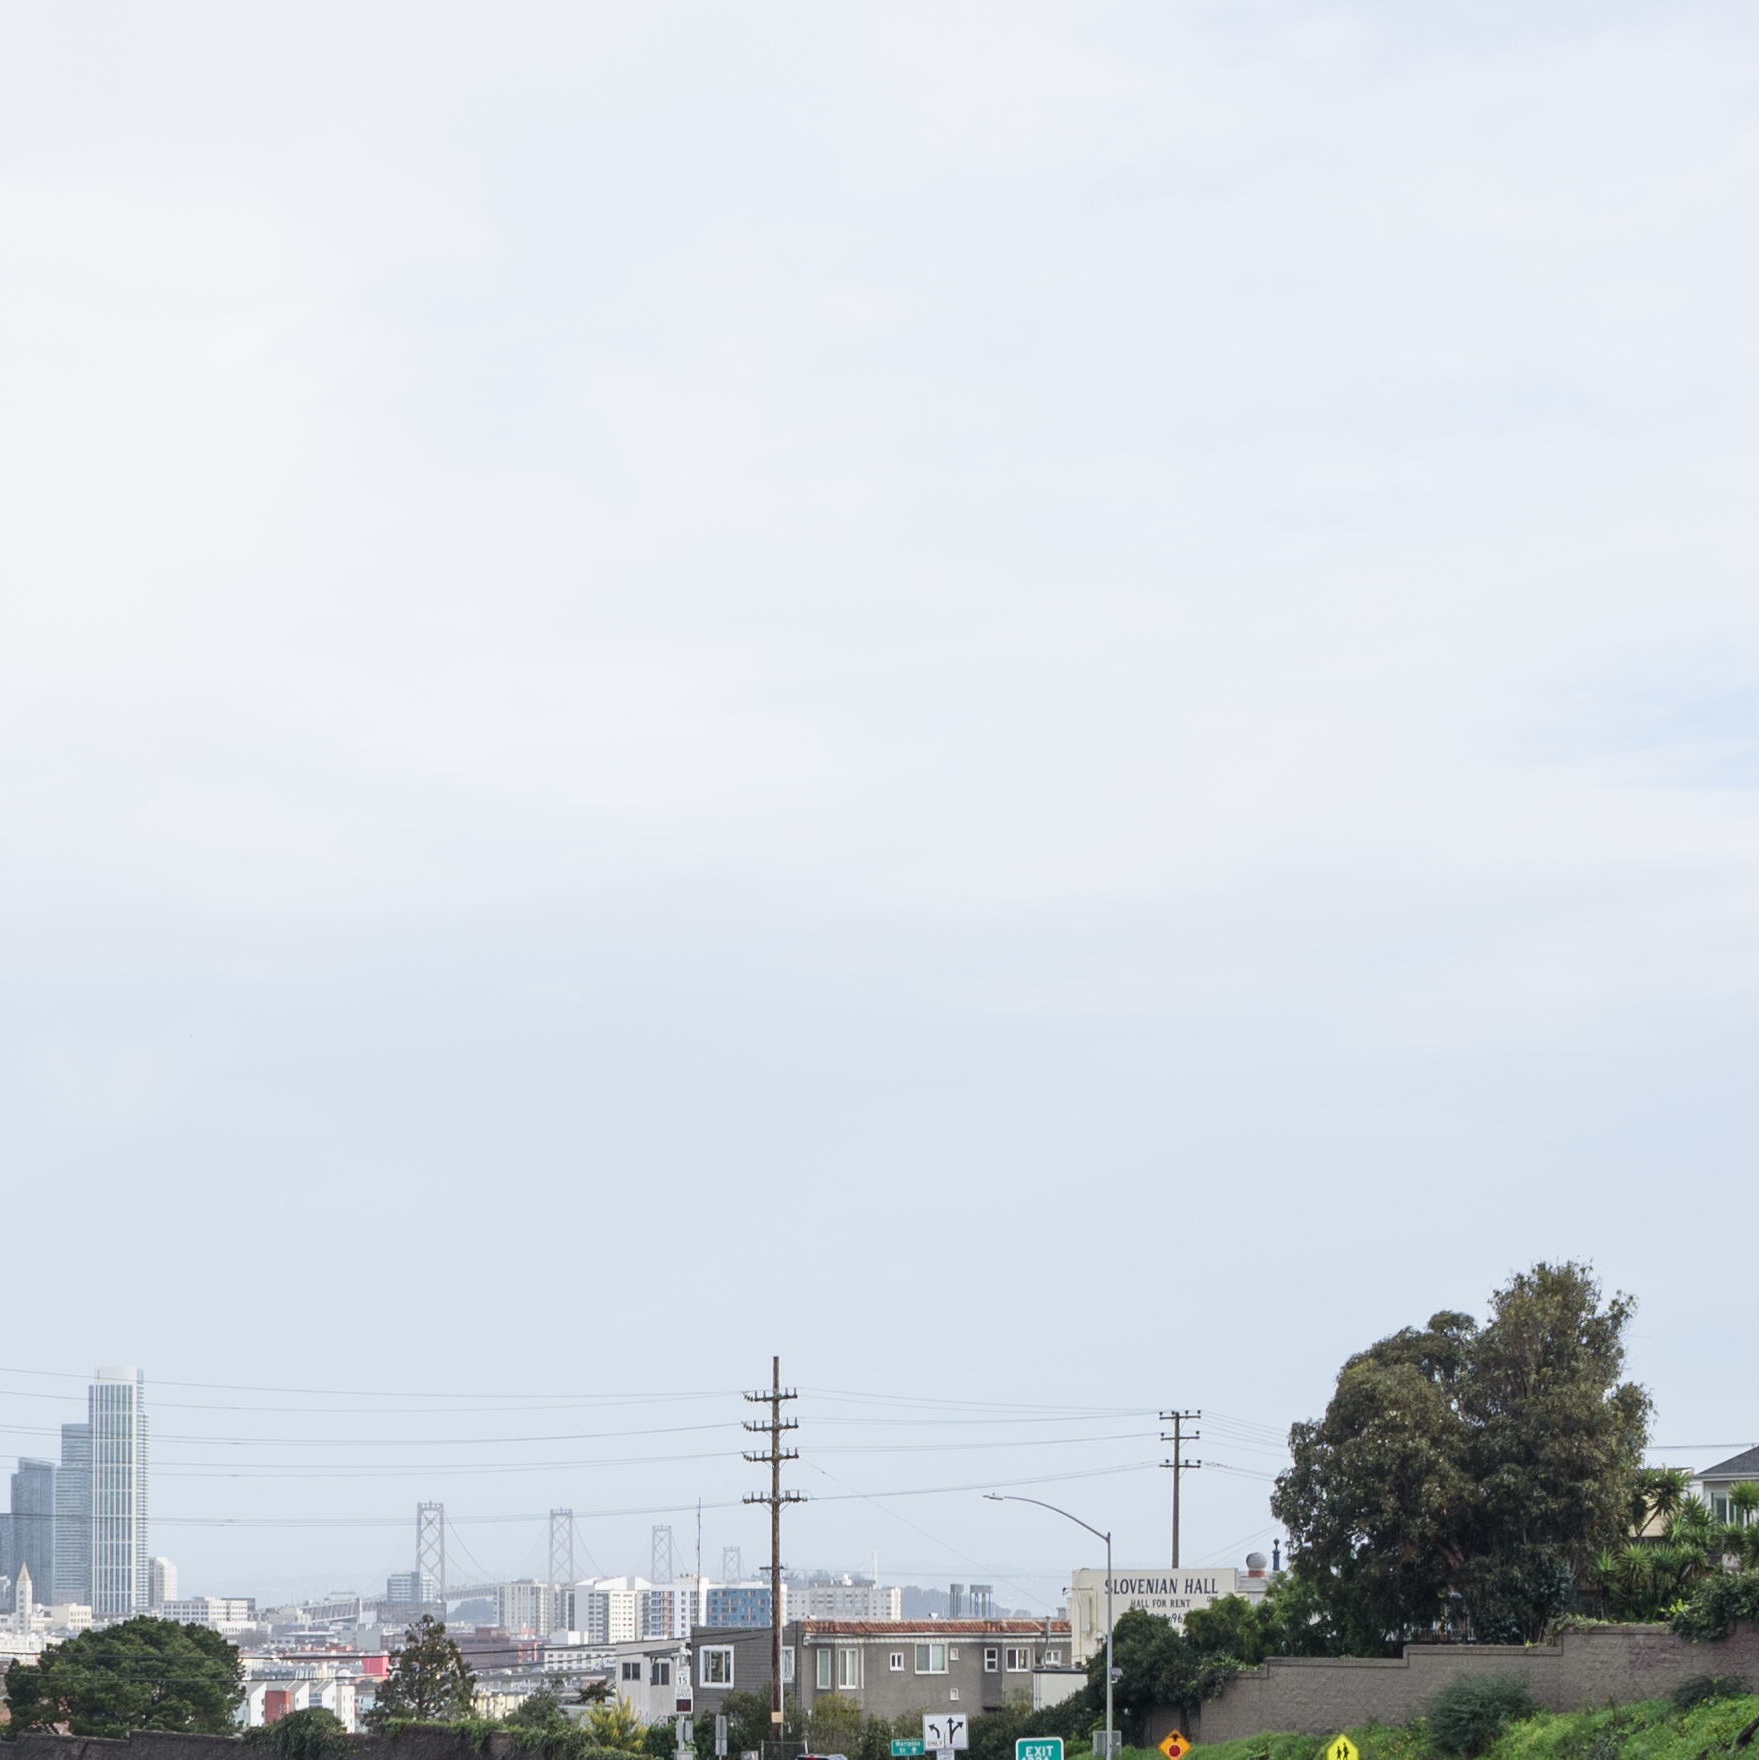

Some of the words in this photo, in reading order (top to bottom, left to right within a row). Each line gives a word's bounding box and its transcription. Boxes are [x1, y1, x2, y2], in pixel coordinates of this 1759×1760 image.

[1104, 1578, 1178, 1595] SLOVENIAN
[1184, 1578, 1219, 1594] HALL
[1130, 1599, 1149, 1608] HALL
[1152, 1599, 1167, 1608] FOR
[1170, 1599, 1191, 1608] RENT
[678, 1676, 688, 1685] 15
[1025, 1745, 1054, 1757] EXIT
